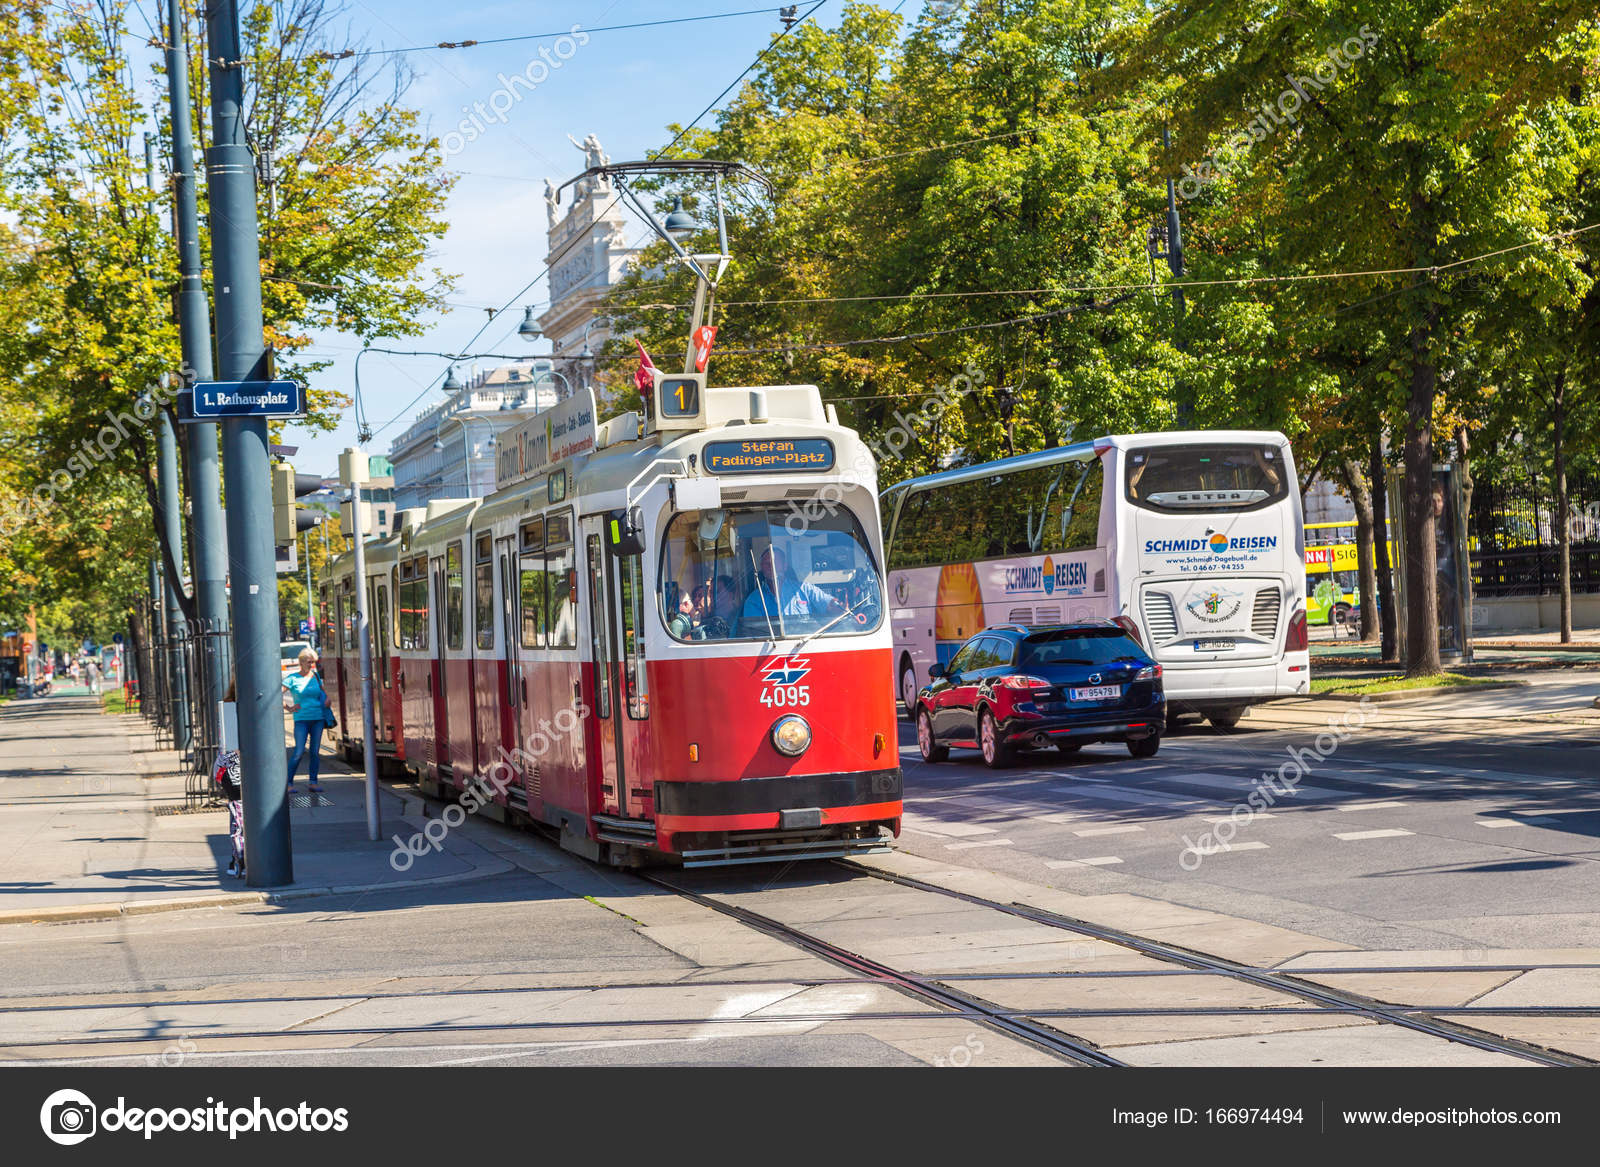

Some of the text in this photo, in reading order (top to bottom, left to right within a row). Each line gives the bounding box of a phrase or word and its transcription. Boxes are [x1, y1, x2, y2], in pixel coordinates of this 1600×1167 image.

[217, 391, 288, 408] Rathausplatz
[674, 385, 685, 410] 1
[741, 441, 794, 453] Stefan
[712, 452, 825, 466] Fadinger-Platz
[1145, 536, 1277, 552] SCHMIDT REISEN
[1005, 561, 1087, 590] SCHMIDT REISEN
[760, 685, 810, 708] 4095
